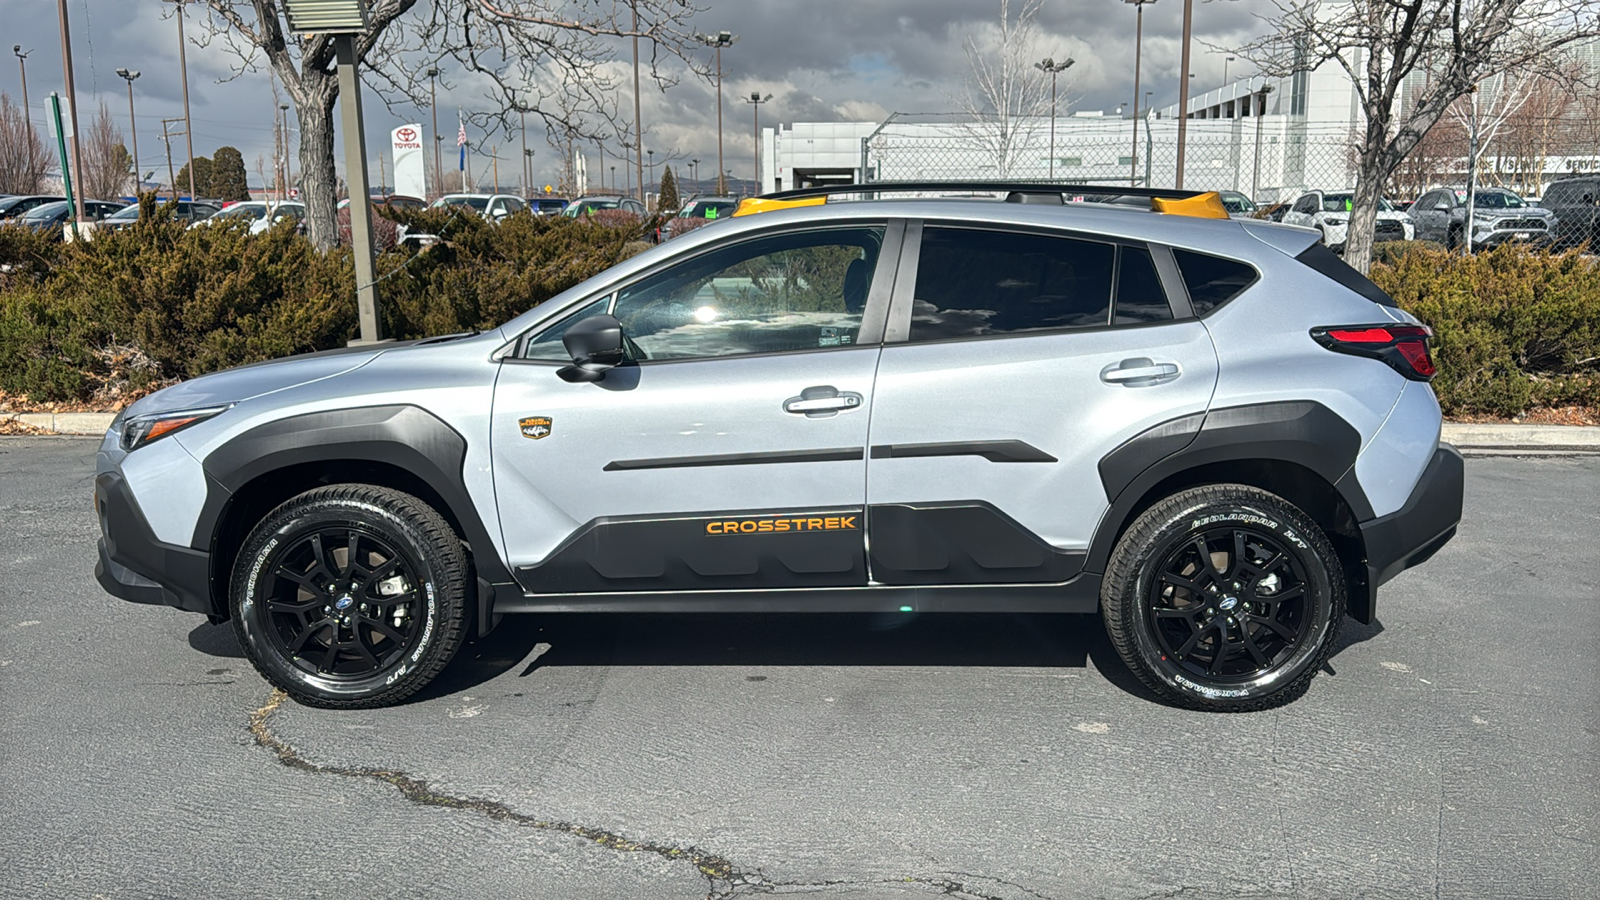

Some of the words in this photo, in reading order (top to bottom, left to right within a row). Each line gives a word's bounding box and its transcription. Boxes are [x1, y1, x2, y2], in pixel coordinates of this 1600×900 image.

[1566, 159, 1600, 170] SERVIC
[706, 516, 856, 534] CROSSTREK
[1191, 513, 1278, 529] GEOLANDAR
[246, 538, 279, 605] YOKOHAMA
[411, 582, 435, 662] GEOLANDAR
[386, 664, 407, 685] A/T
[1174, 674, 1249, 697] YOKOHAMA
